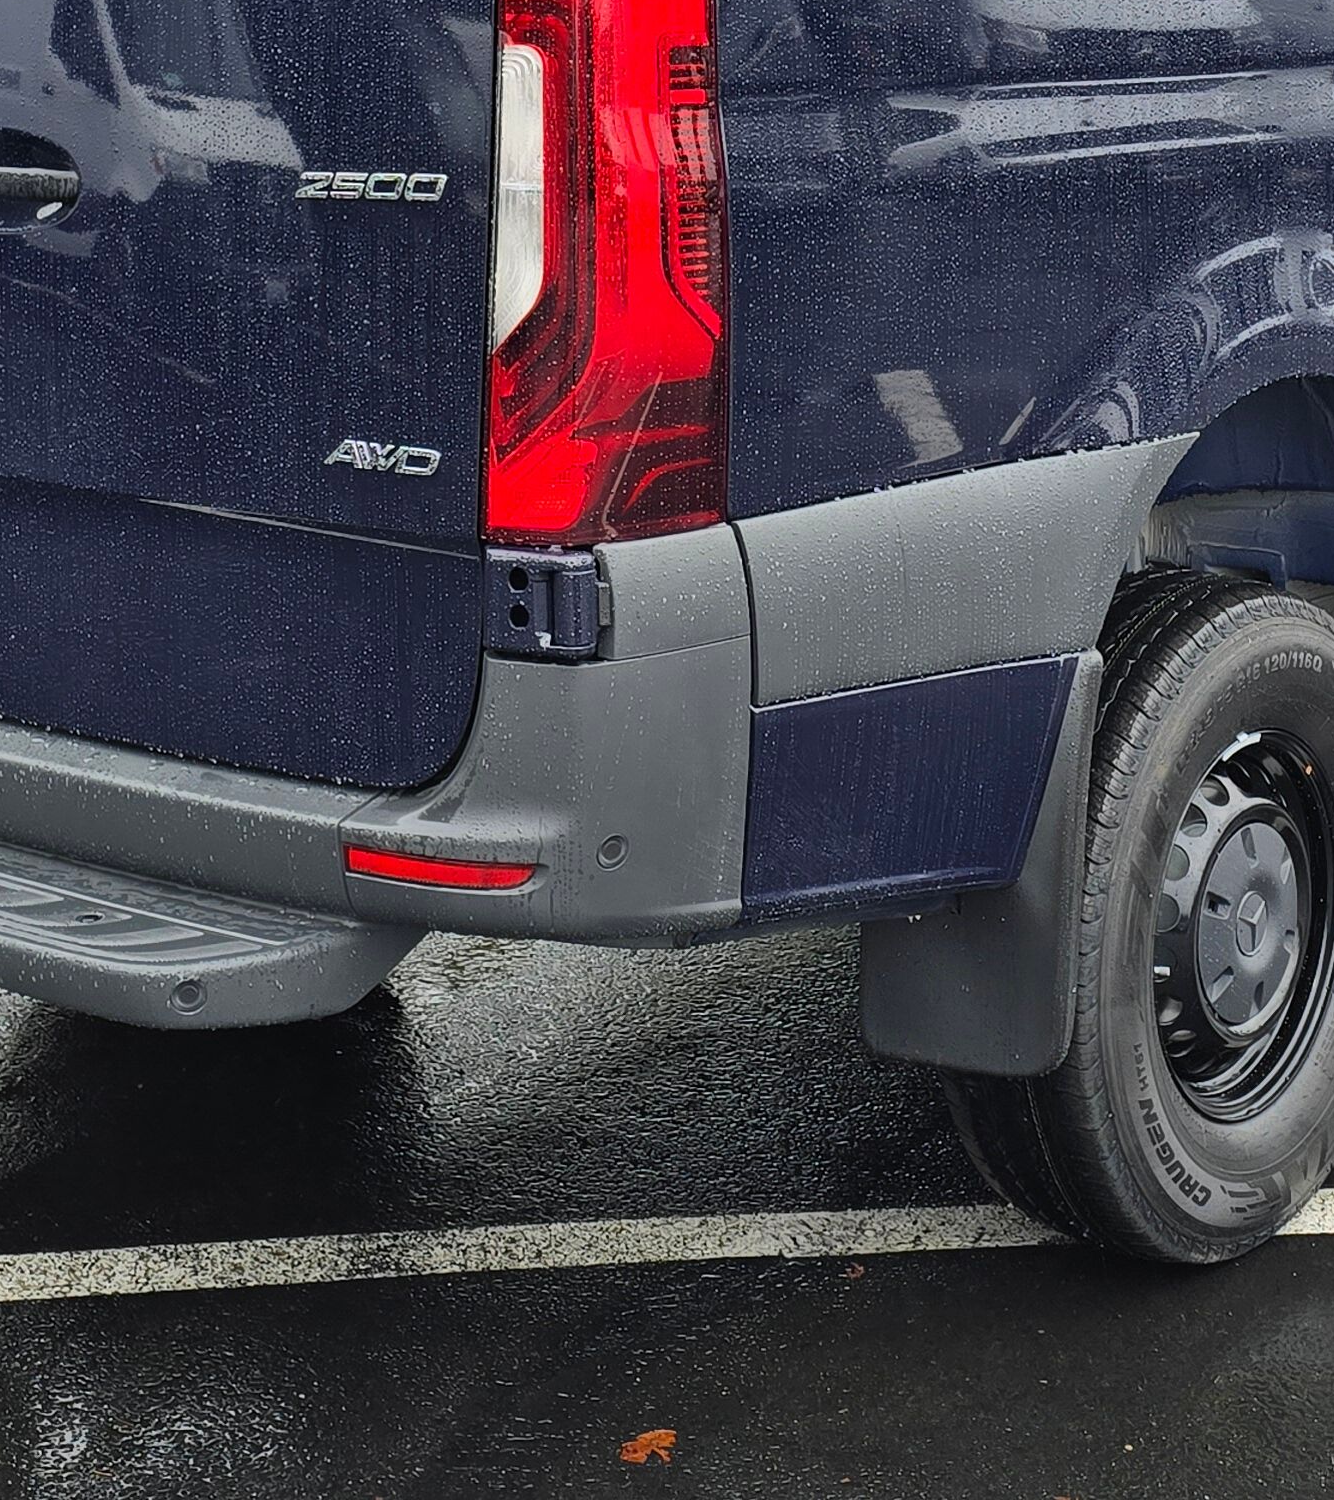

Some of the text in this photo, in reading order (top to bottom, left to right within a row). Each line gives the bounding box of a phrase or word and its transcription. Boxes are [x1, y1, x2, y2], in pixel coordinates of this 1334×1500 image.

[295, 171, 449, 202] 2500
[323, 438, 442, 476] AWD
[1264, 650, 1323, 674] 120/116Q
[1138, 1098, 1212, 1208] CRUGEN
